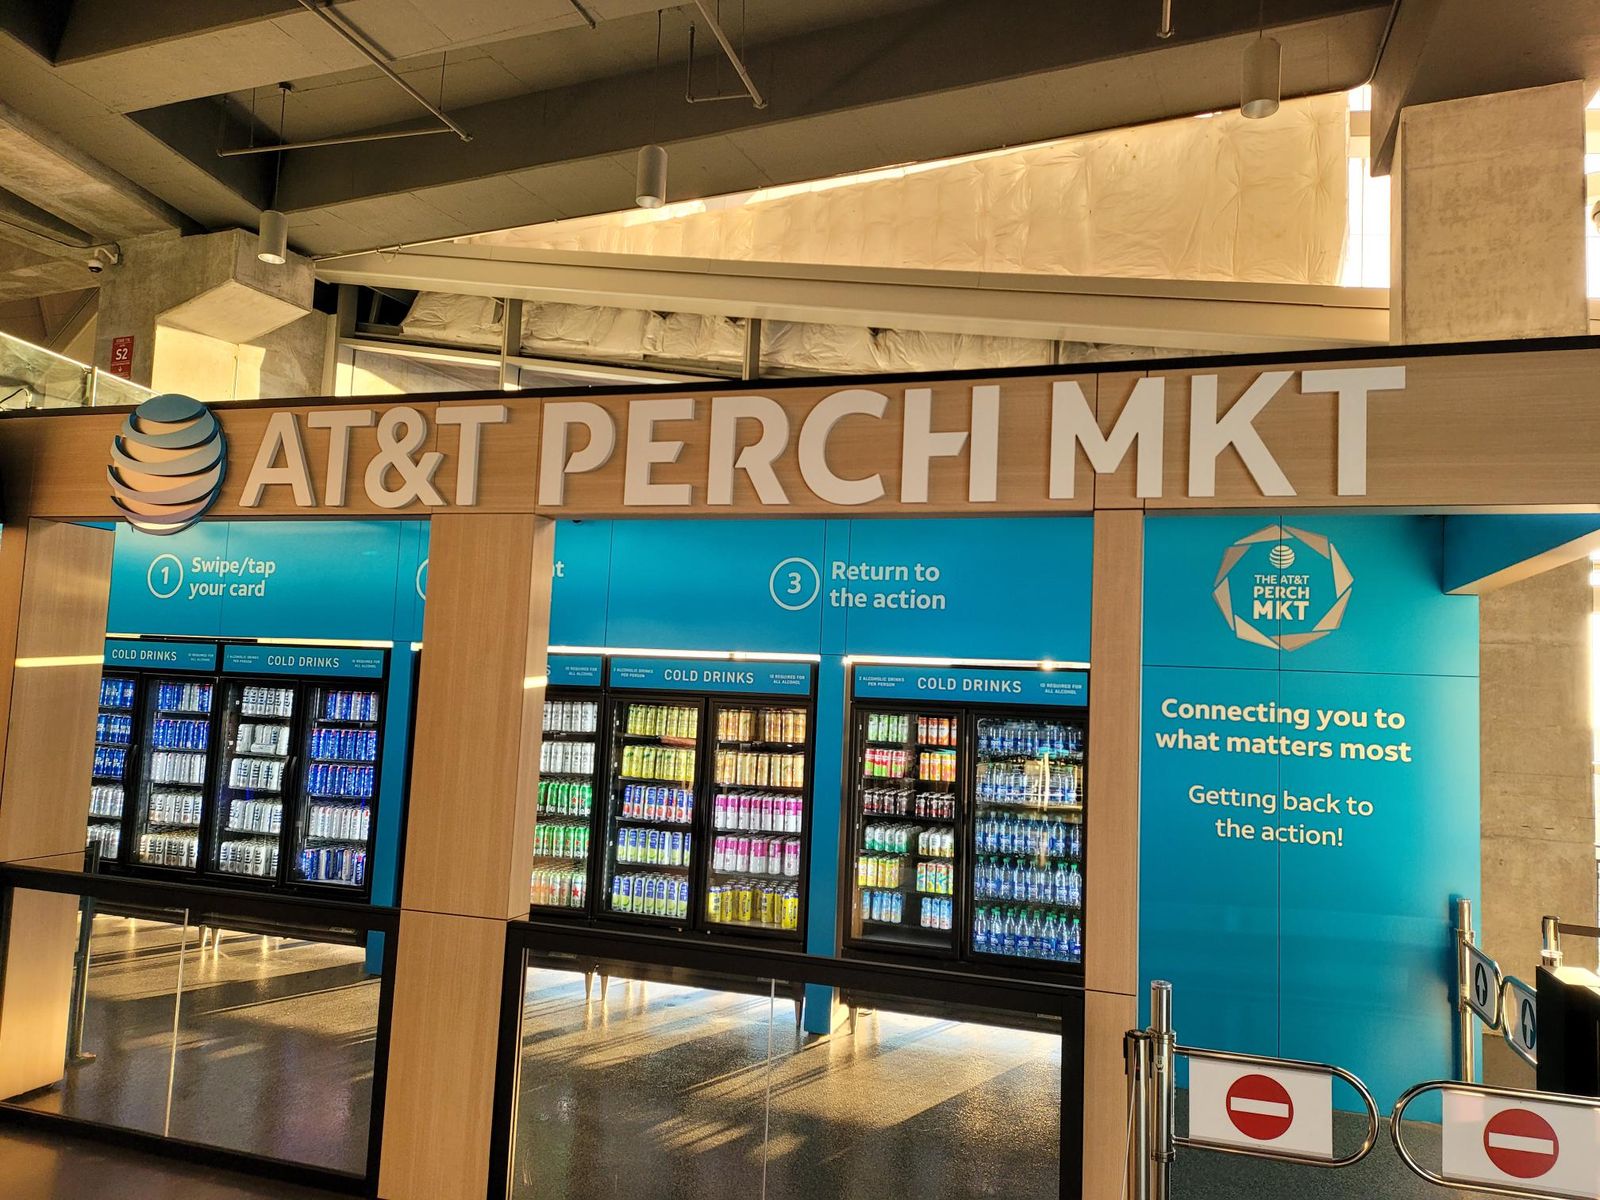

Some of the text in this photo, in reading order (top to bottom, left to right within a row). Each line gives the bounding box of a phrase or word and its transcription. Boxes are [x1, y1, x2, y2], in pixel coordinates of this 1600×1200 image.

[115, 348, 128, 360] S2
[239, 366, 1406, 508] AT&T PERCH MKT
[161, 566, 170, 584] 1
[191, 556, 276, 578] Swipe/tap
[832, 561, 940, 581] Return to
[188, 580, 266, 599] your card
[787, 572, 801, 594] 3
[1254, 574, 1310, 585] THE AT&T
[830, 588, 946, 610] the action
[1253, 586, 1310, 599] PERCH
[1253, 600, 1310, 620] MKT
[112, 649, 137, 659] COLD
[140, 650, 177, 661] DRINKS
[267, 655, 295, 666] COLD
[298, 656, 340, 668] DRINKS
[664, 669, 754, 684] COLD DRINKS
[917, 677, 1022, 693] COLD DRINKS
[1161, 698, 1406, 731] Connecting you to
[1155, 729, 1412, 763] what matters most
[1188, 785, 1374, 817] Getting back to
[1215, 818, 1344, 847] the action!
